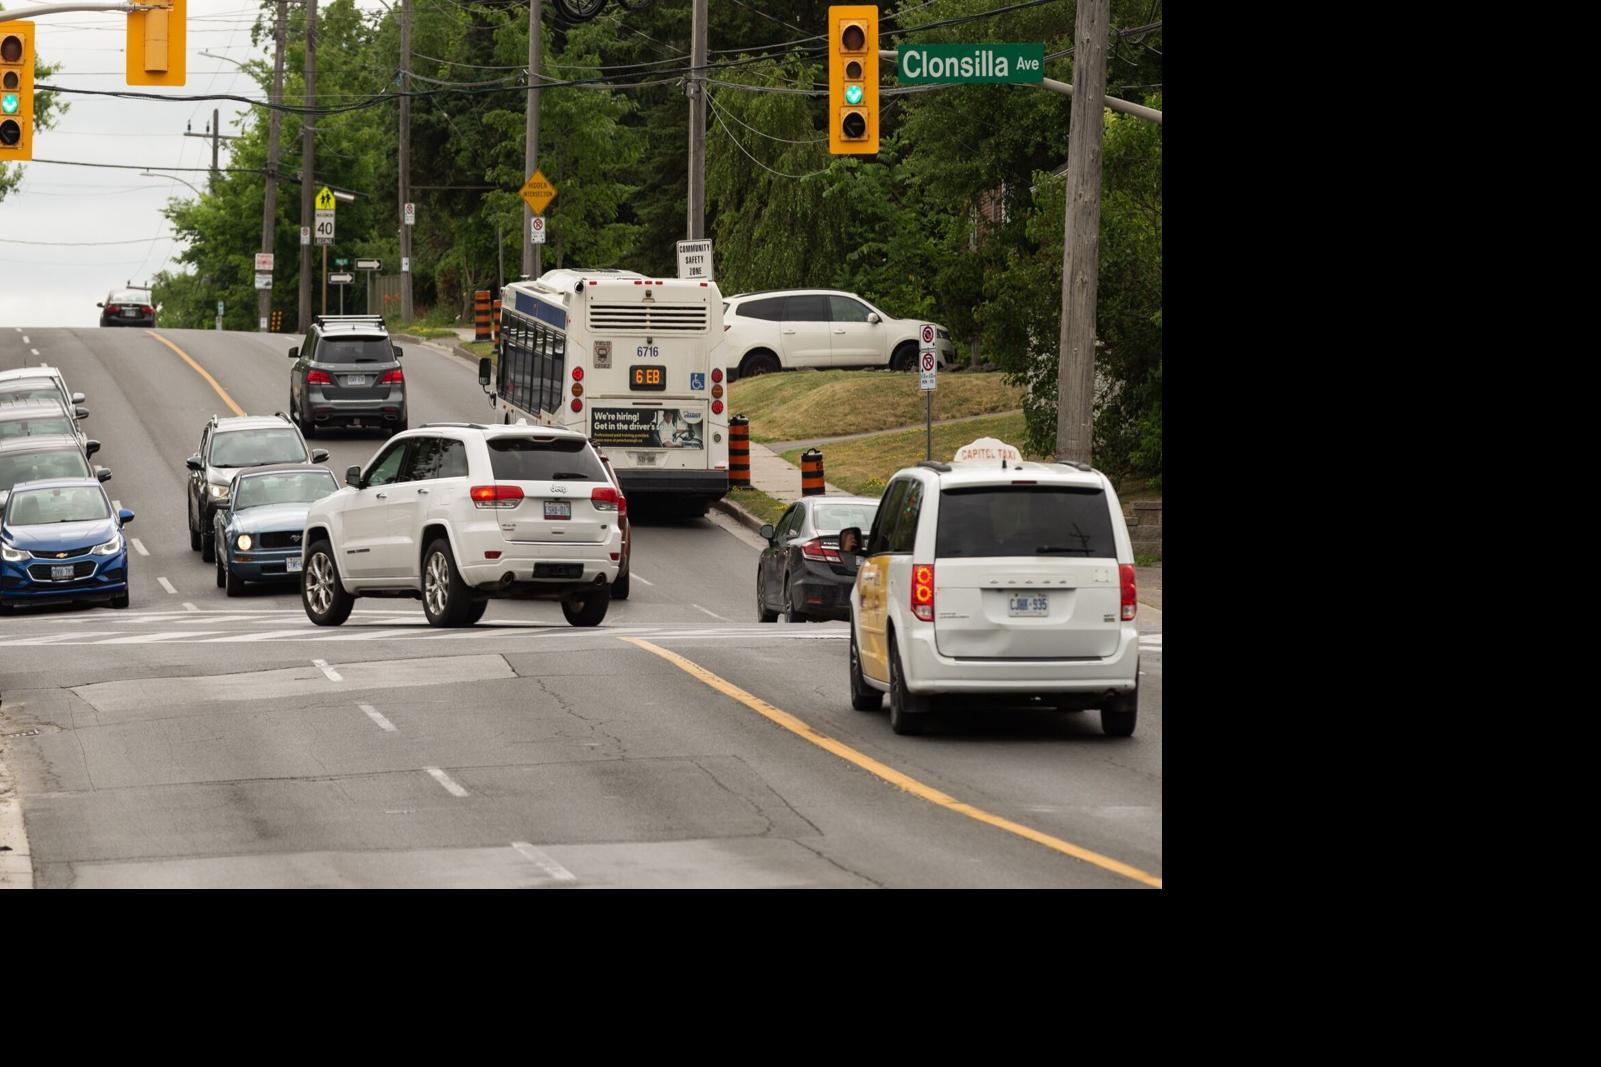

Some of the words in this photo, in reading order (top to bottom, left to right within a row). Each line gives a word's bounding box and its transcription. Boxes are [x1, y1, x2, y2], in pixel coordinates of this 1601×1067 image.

[902, 50, 1009, 78] Clonsilla
[1016, 56, 1040, 71] Ave
[317, 222, 333, 235] 40
[680, 244, 710, 253] COMMUNITY
[685, 255, 704, 264] SAFETY
[689, 267, 702, 276] ZONE
[636, 346, 659, 357] 6716
[635, 369, 643, 384] 6
[646, 369, 660, 384] EB
[594, 411, 616, 420] We're
[616, 411, 640, 422] hiring!
[594, 422, 607, 430] Get
[608, 422, 616, 430] in
[616, 422, 628, 430] the
[629, 422, 655, 430] driver's
[962, 448, 996, 460] CAPITOL
[998, 448, 1016, 460] TAXI
